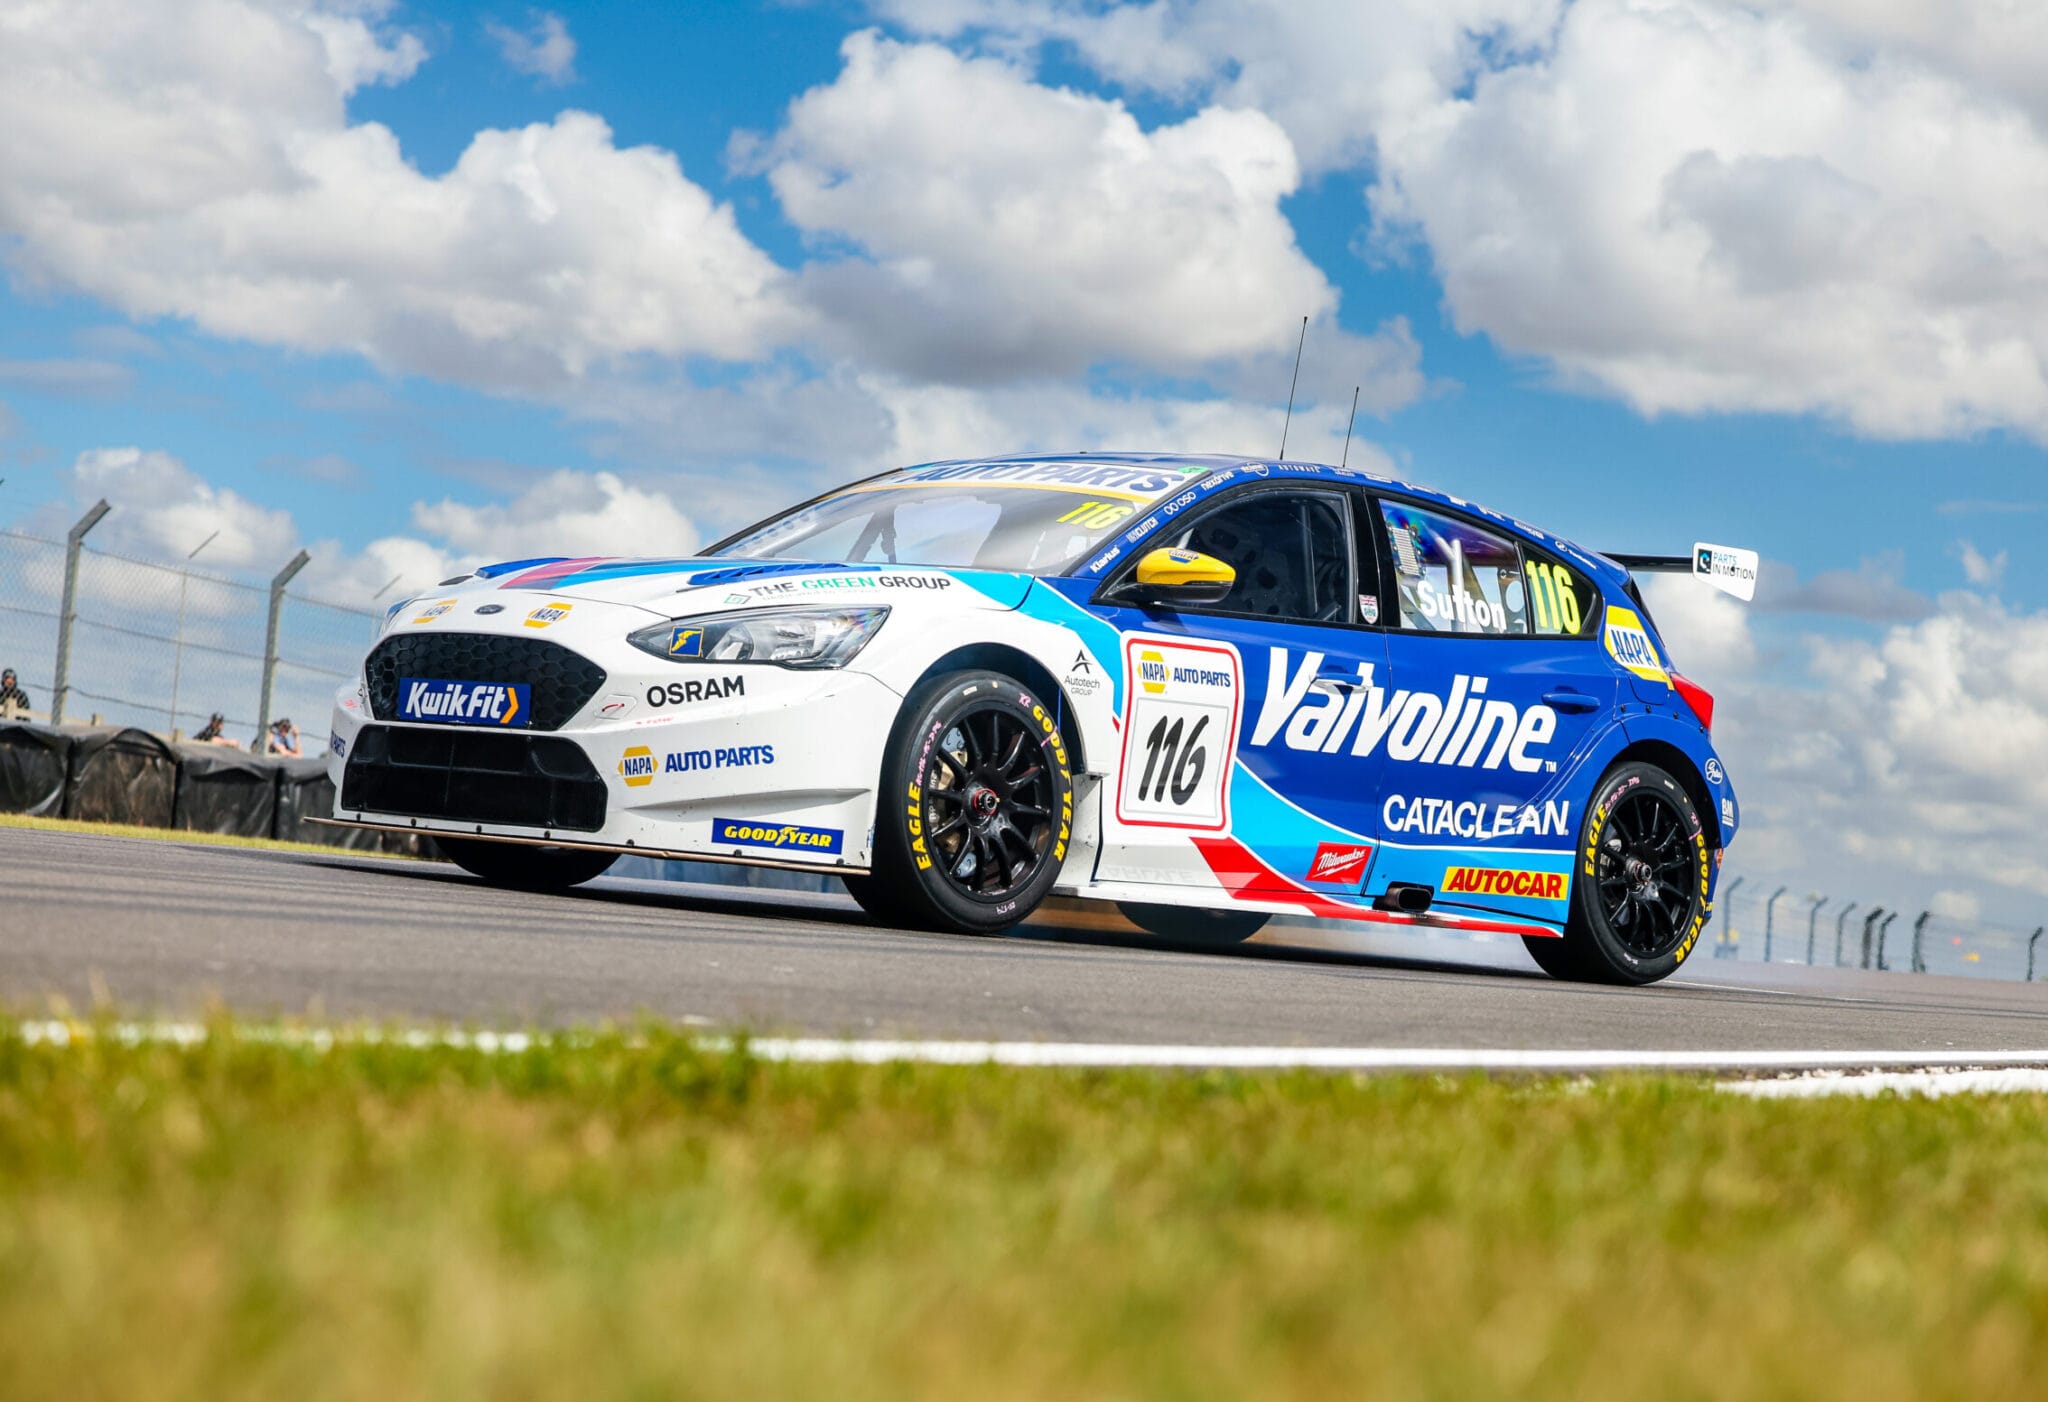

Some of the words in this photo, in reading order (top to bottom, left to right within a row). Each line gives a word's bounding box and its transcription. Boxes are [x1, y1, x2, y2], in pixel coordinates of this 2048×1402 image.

[1036, 464, 1185, 491] PARTS
[1056, 501, 1133, 530] 116
[1090, 546, 1121, 573] Klarius
[1712, 563, 1722, 575] IN
[1722, 565, 1755, 580] MOTION
[1713, 551, 1737, 566] PARTS
[748, 582, 798, 597] THE
[801, 577, 876, 590] GREEN
[878, 576, 951, 590] GROUP
[1526, 560, 1581, 635] 116
[533, 608, 566, 621] NAPA
[1417, 580, 1506, 631] Sutton
[1611, 629, 1657, 667] NAPA
[1064, 675, 1100, 689] Autotech
[1142, 662, 1166, 682] NAPA
[1173, 667, 1199, 684] AUTO
[1200, 670, 1231, 688] PARTS
[646, 675, 745, 707] OSRAM
[1071, 688, 1093, 696] GROUP
[1250, 646, 1557, 773] Valvoline
[624, 756, 653, 776] NAPA
[665, 750, 712, 773] AUTO
[715, 745, 775, 769] PARTS
[1138, 714, 1210, 806] 116
[908, 781, 932, 871] EAGLE
[1383, 794, 1570, 838] CATACLEAN
[1585, 804, 1606, 877] EAGLE
[1317, 848, 1366, 871] Milwaukee
[1448, 868, 1562, 899] AUTOCAR
